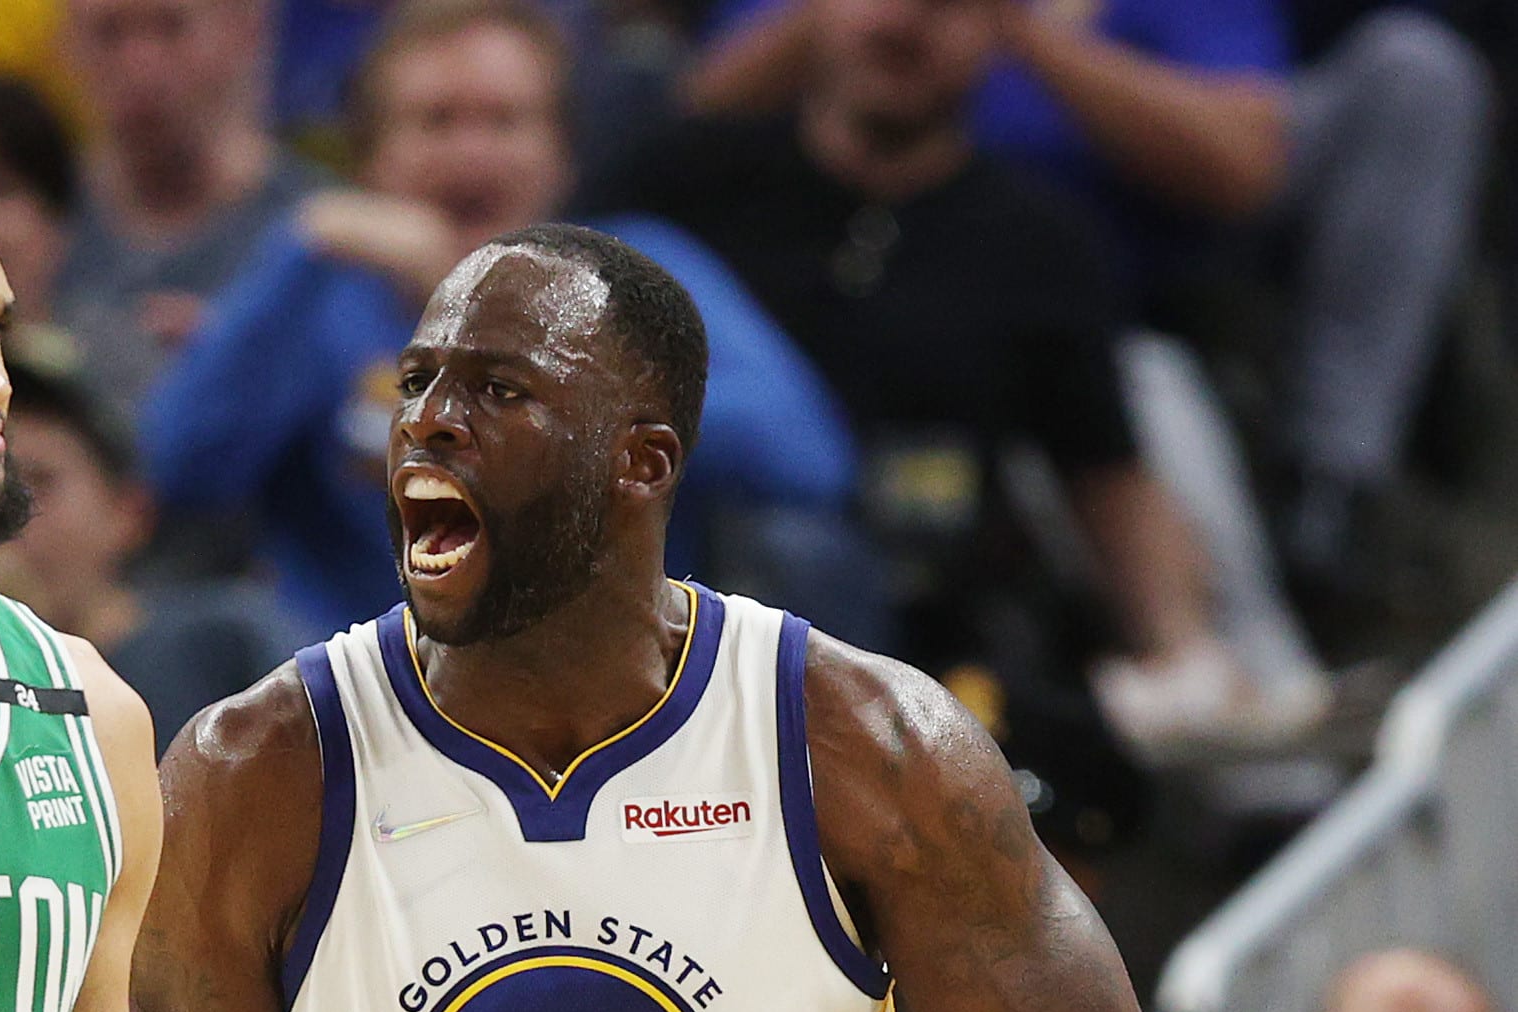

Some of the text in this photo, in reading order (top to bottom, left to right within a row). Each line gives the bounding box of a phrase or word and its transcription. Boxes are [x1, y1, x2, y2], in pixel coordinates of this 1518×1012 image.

[14, 755, 81, 799] VISTA
[27, 795, 87, 830] PRINT
[624, 800, 751, 830] Rakuten
[399, 910, 723, 1012] GOLDEN STATE
